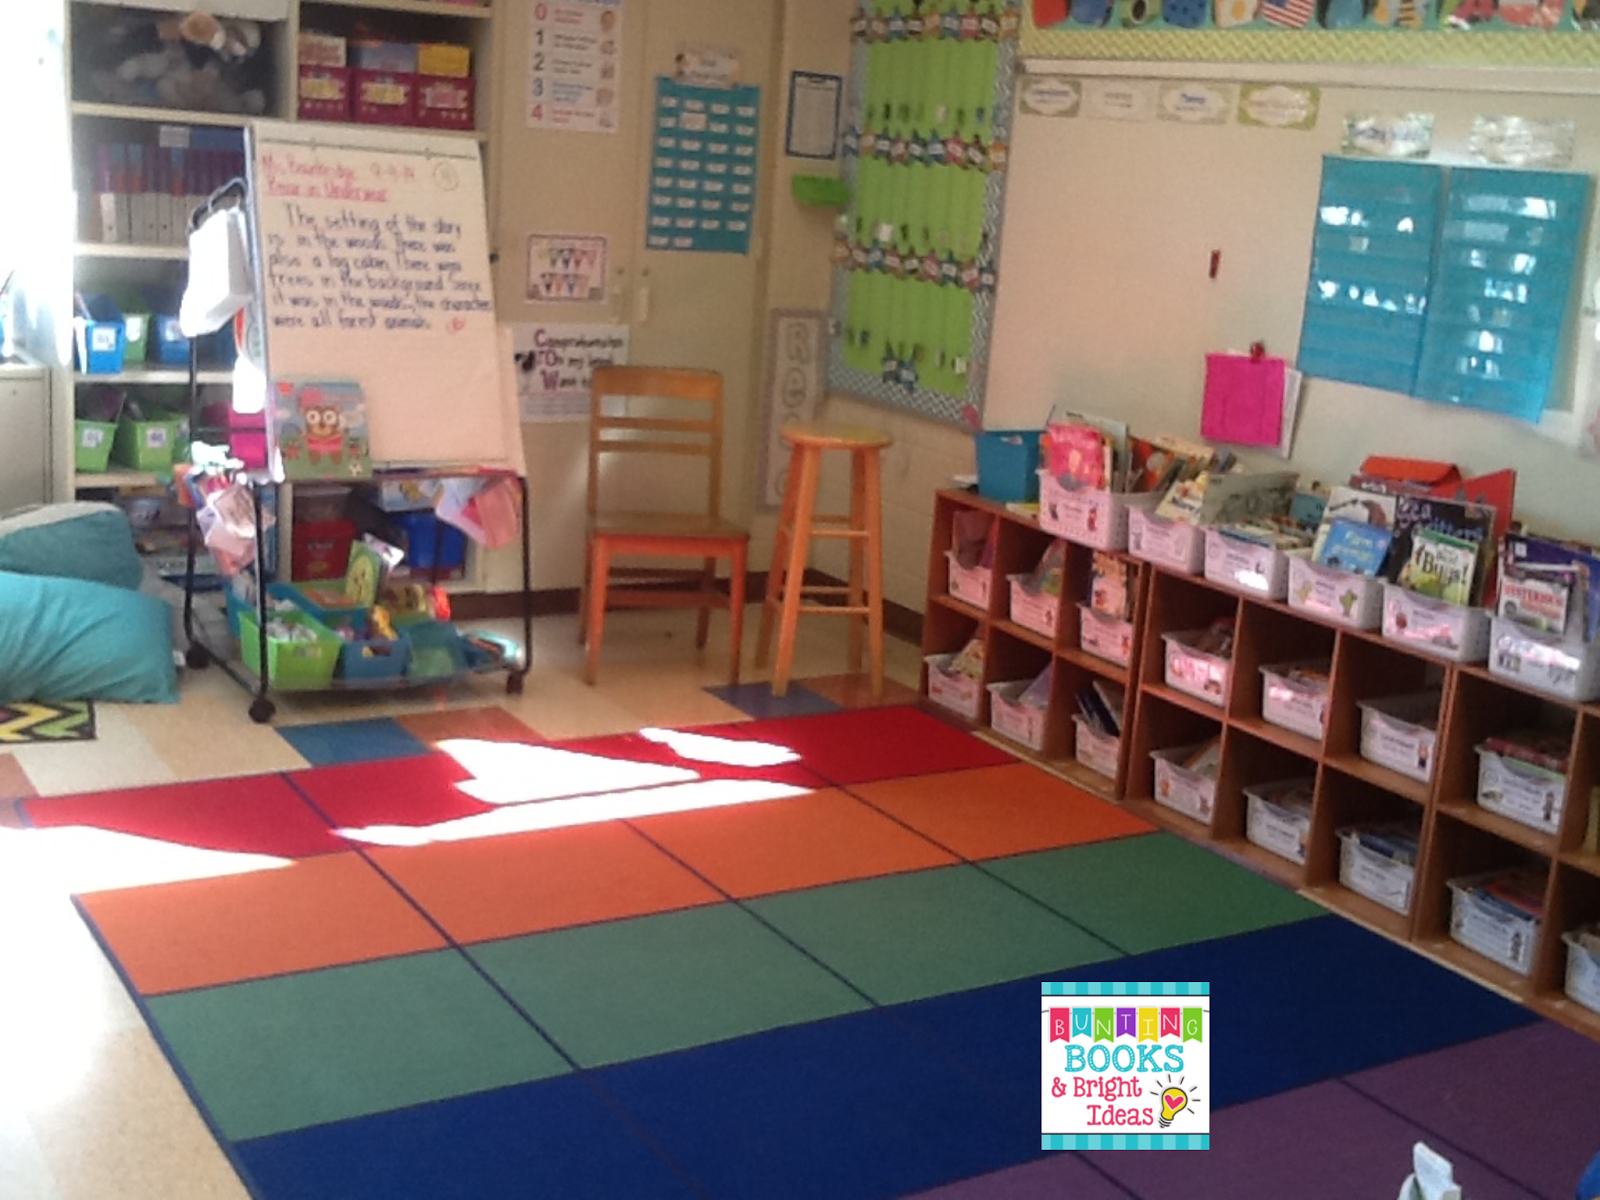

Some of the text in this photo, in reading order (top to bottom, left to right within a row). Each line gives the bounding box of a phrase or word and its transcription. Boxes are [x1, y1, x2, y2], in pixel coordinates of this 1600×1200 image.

[534, 3, 547, 20] 0
[536, 29, 544, 45] 1
[533, 52, 545, 71] 2
[532, 78, 543, 97] 3
[531, 104, 543, 120] 4
[284, 202, 315, 228] The
[325, 209, 380, 240] setting
[313, 256, 322, 268] a
[311, 308, 332, 328] all
